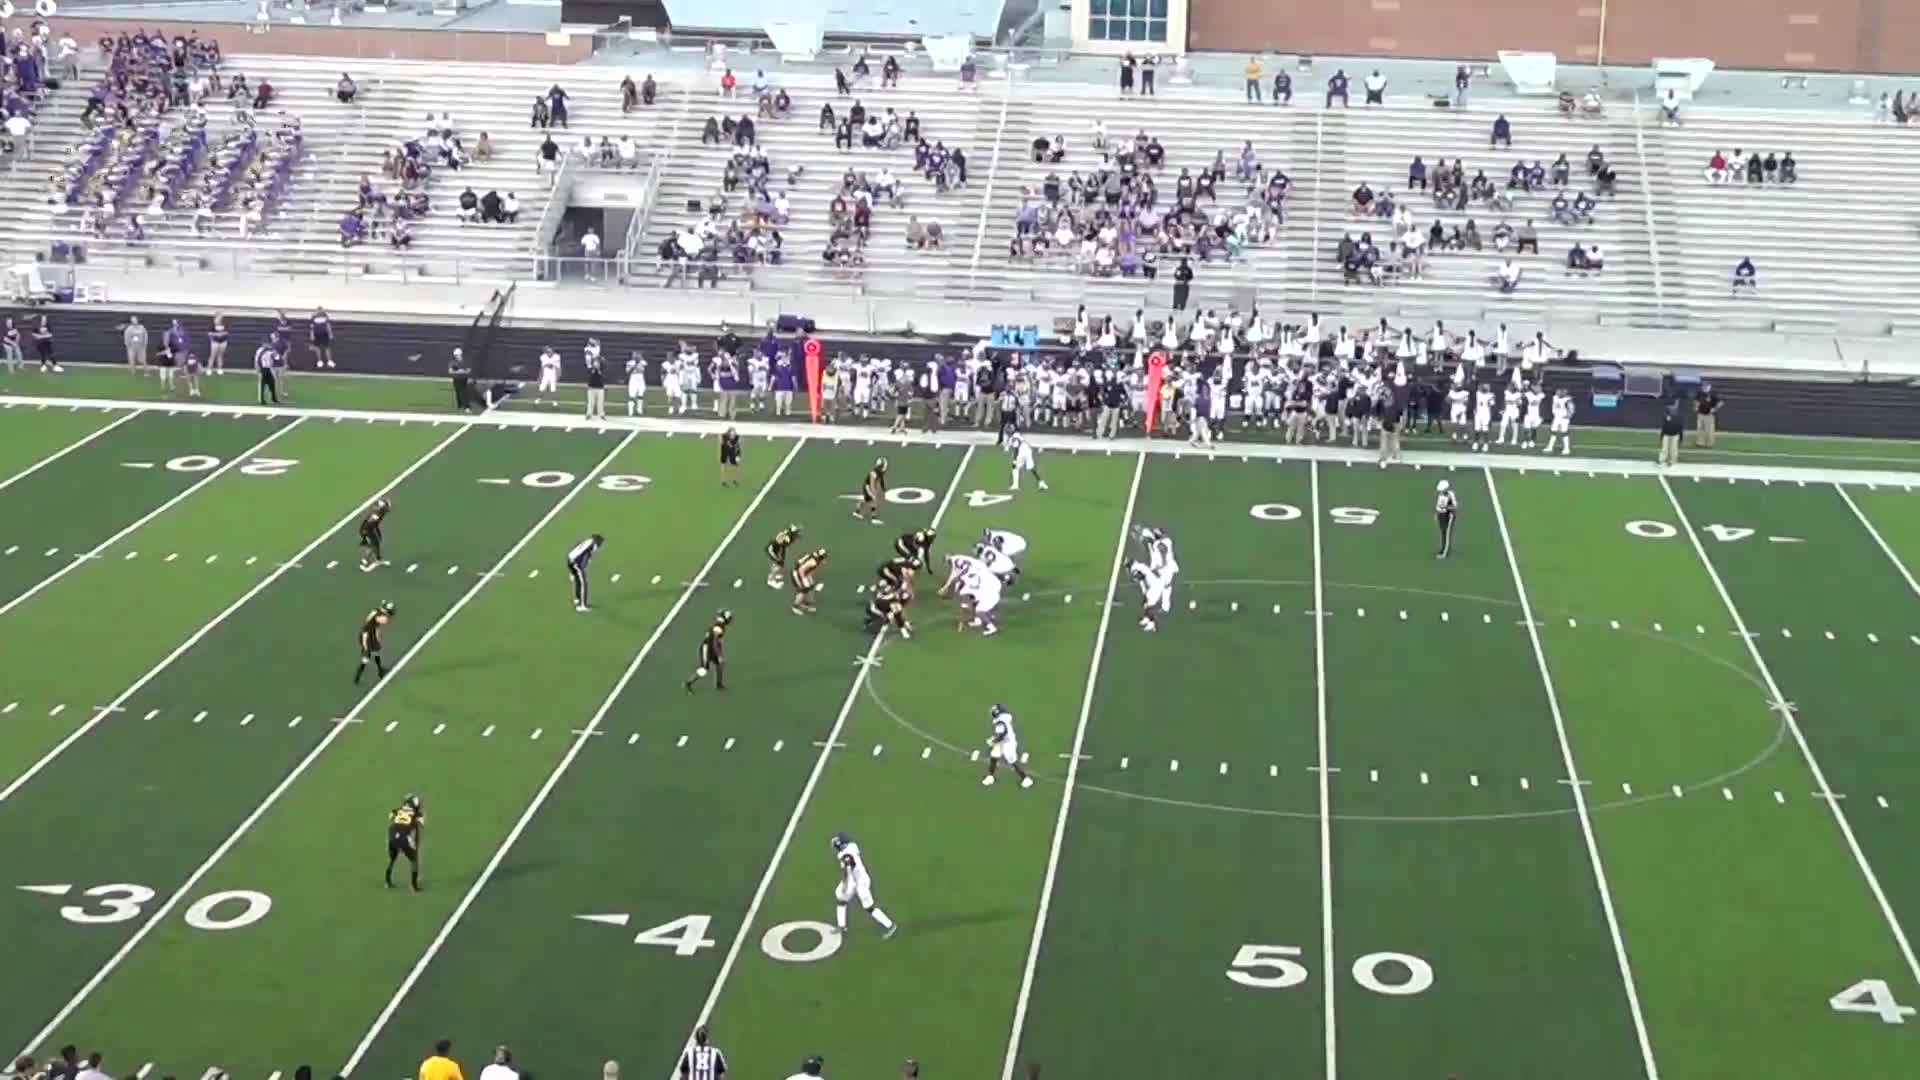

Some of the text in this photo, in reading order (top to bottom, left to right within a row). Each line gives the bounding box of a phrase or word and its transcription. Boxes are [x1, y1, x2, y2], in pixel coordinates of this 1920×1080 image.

[60, 884, 272, 931] 30
[634, 914, 843, 962] 40
[1226, 944, 1434, 995] 50
